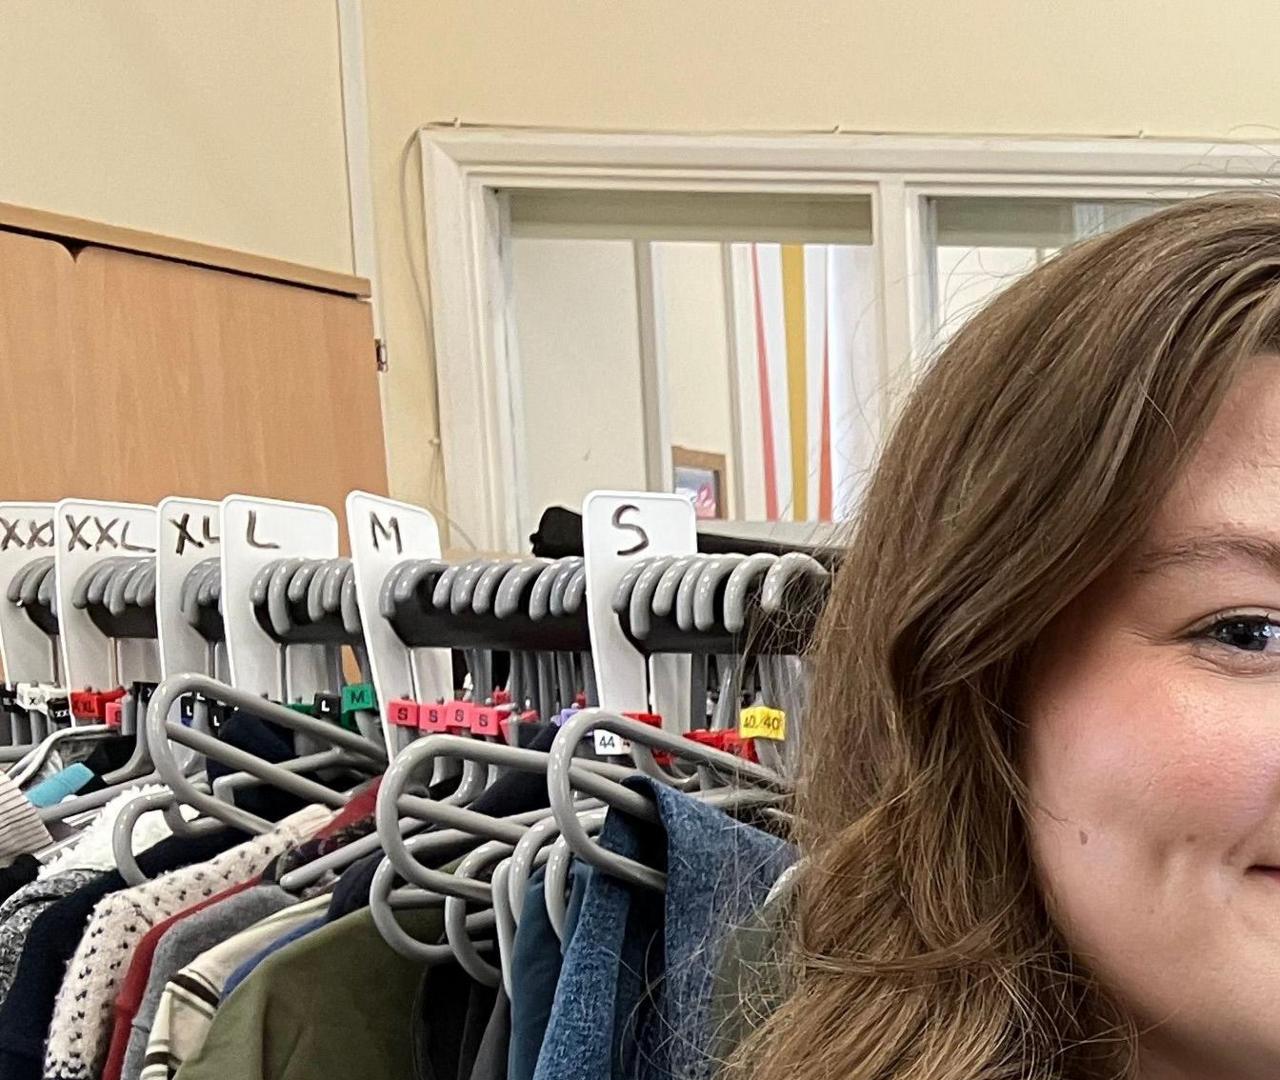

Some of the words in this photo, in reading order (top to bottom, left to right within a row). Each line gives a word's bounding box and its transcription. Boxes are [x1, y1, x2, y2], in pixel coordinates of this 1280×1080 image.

[65, 514, 156, 552] XXL
[168, 513, 220, 556] XL
[246, 510, 281, 549] L
[369, 511, 401, 555] M
[612, 504, 649, 556] S
[350, 690, 364, 703] M
[321, 700, 330, 712] L
[397, 708, 408, 720] S
[429, 710, 438, 723] S
[454, 709, 464, 722] S
[478, 714, 488, 727] S
[599, 736, 615, 748] 44
